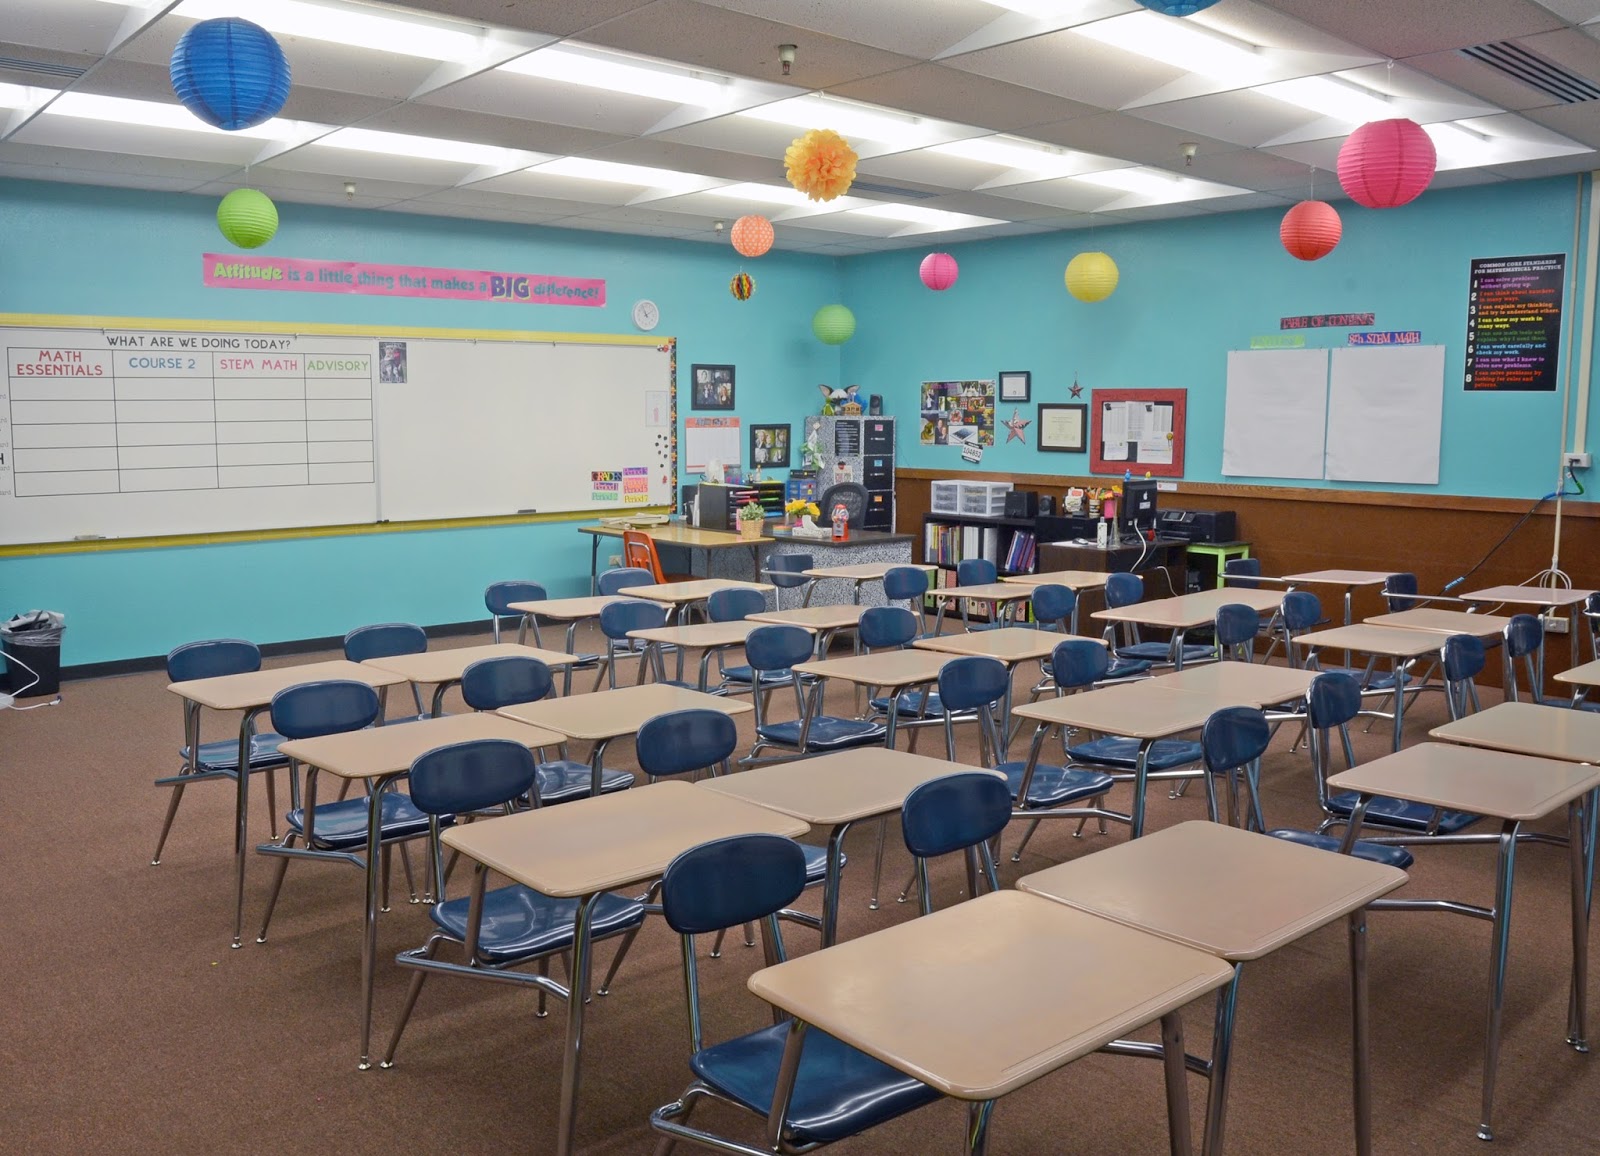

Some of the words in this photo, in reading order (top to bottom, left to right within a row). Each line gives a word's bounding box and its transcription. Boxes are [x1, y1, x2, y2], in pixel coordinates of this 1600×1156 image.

[214, 262, 283, 281] Attitude
[288, 268, 299, 281] is
[304, 271, 314, 282] a
[319, 269, 353, 284] little
[357, 271, 394, 289] thing
[399, 274, 426, 288] that
[431, 277, 475, 291] makes
[480, 281, 486, 292] a
[490, 275, 530, 300] BIG
[533, 282, 599, 299] difference!
[1474, 280, 1478, 288] 1
[1471, 292, 1477, 301] 2
[1470, 306, 1476, 314] 3
[1367, 332, 1390, 343] STEM
[1395, 332, 1419, 343] MATH
[1469, 332, 1474, 341] 5
[107, 336, 144, 347] WHAT
[150, 337, 173, 347] ARE
[179, 338, 197, 348] WE
[202, 338, 240, 348] DOING
[244, 339, 291, 349] TODAY?
[1468, 345, 1473, 353] 6
[38, 351, 82, 362] MATH
[129, 358, 182, 369] COURSE
[188, 358, 195, 369] 2
[220, 359, 254, 370] STEM
[262, 360, 298, 370] MATH
[307, 361, 368, 371] ADVISORY
[1467, 358, 1472, 366] 7
[17, 364, 103, 376] ESSENTIALS
[1466, 374, 1472, 382] 8
